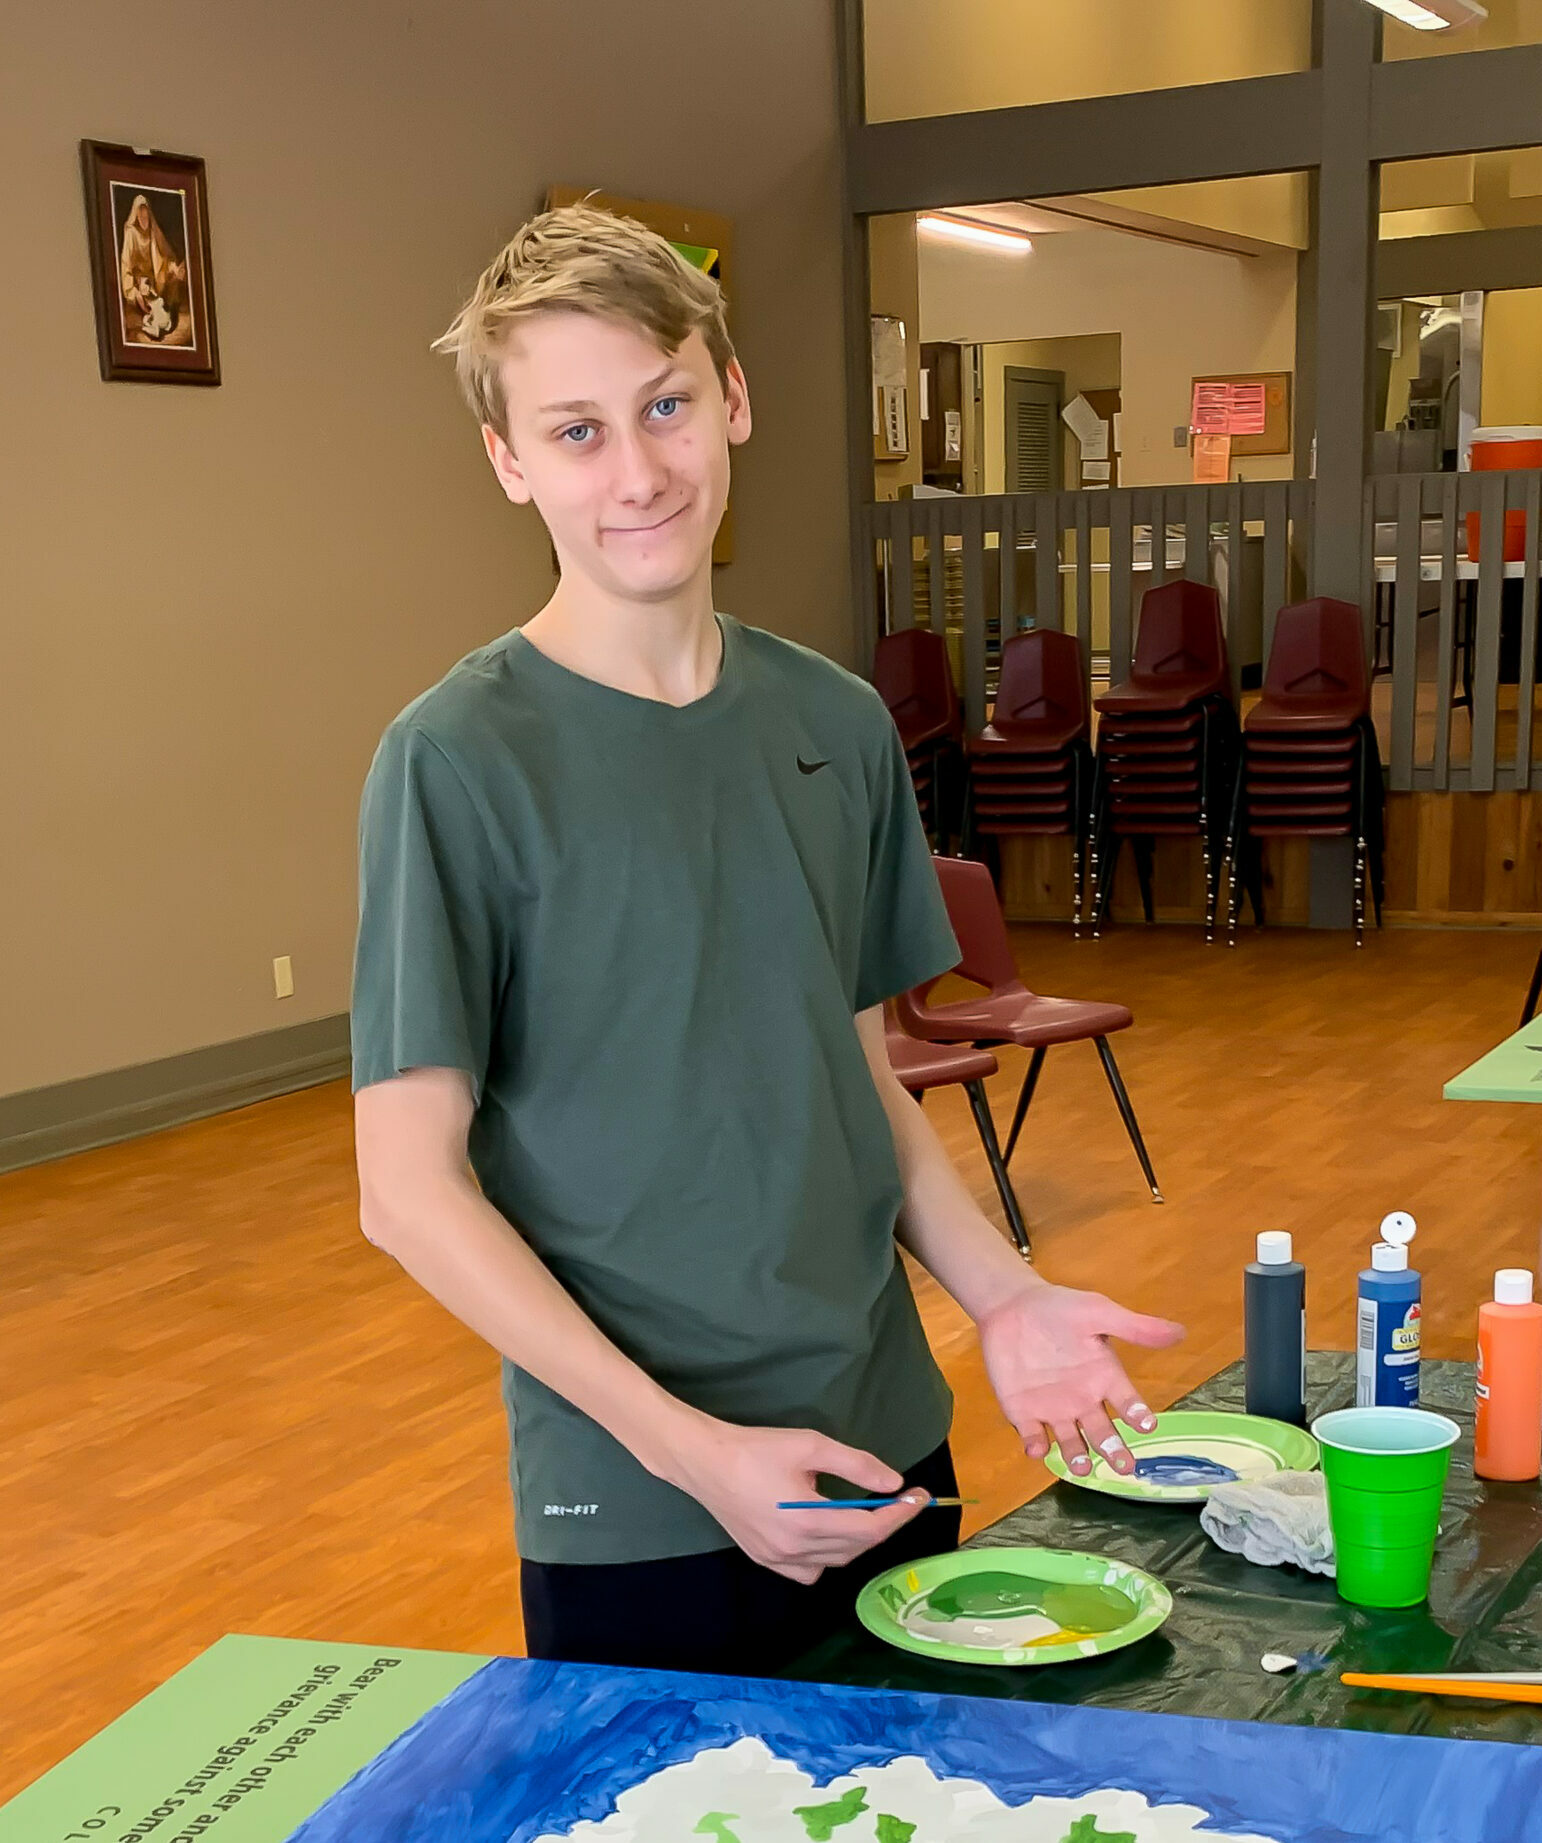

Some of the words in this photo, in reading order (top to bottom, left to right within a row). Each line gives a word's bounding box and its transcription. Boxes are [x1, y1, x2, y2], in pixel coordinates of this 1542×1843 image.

[543, 1504, 599, 1516] DRI-FIT
[349, 1658, 402, 1690] Bear
[248, 1664, 341, 1735] grievance
[308, 1692, 359, 1724] with
[263, 1728, 317, 1762] each
[175, 1737, 257, 1795] against
[211, 1766, 273, 1811] other
